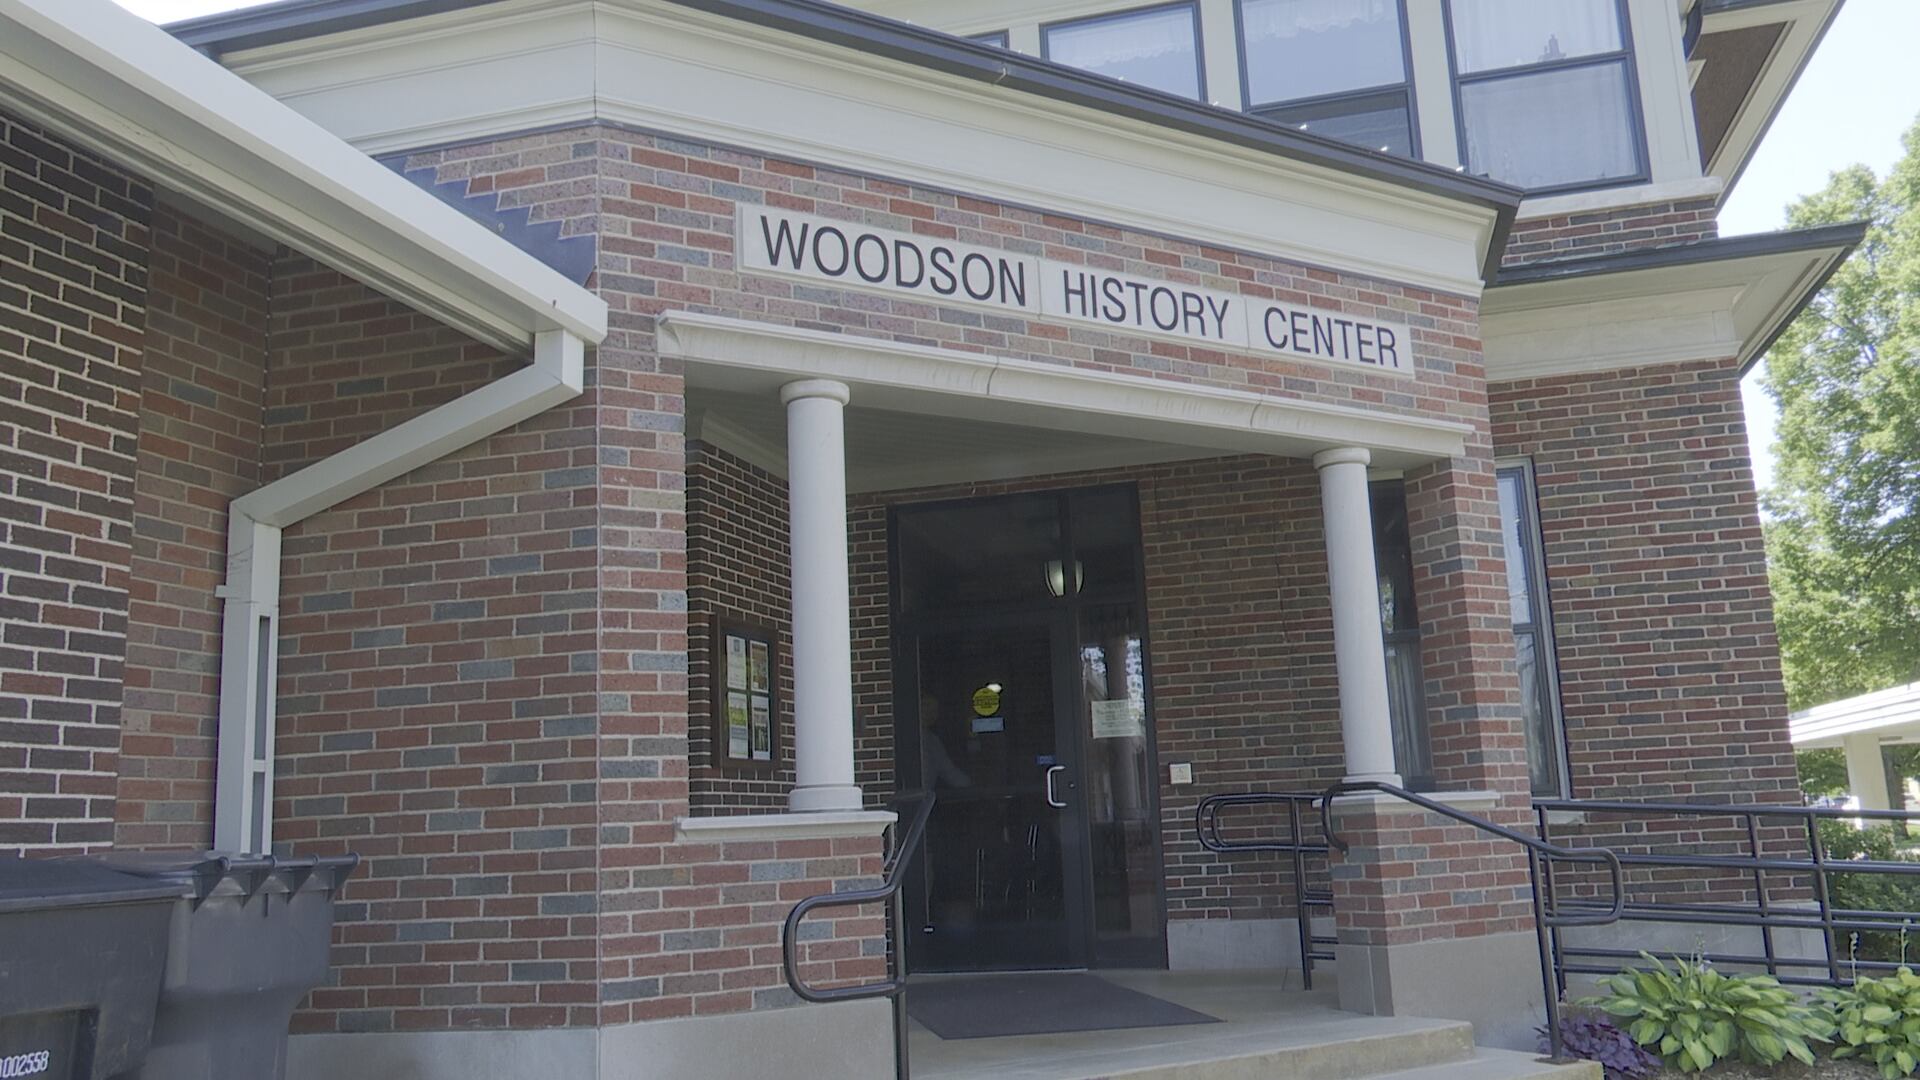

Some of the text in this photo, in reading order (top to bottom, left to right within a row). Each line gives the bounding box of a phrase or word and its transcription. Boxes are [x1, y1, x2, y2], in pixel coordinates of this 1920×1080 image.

[760, 214, 1399, 368] WOODSON HISTORY CENTER
